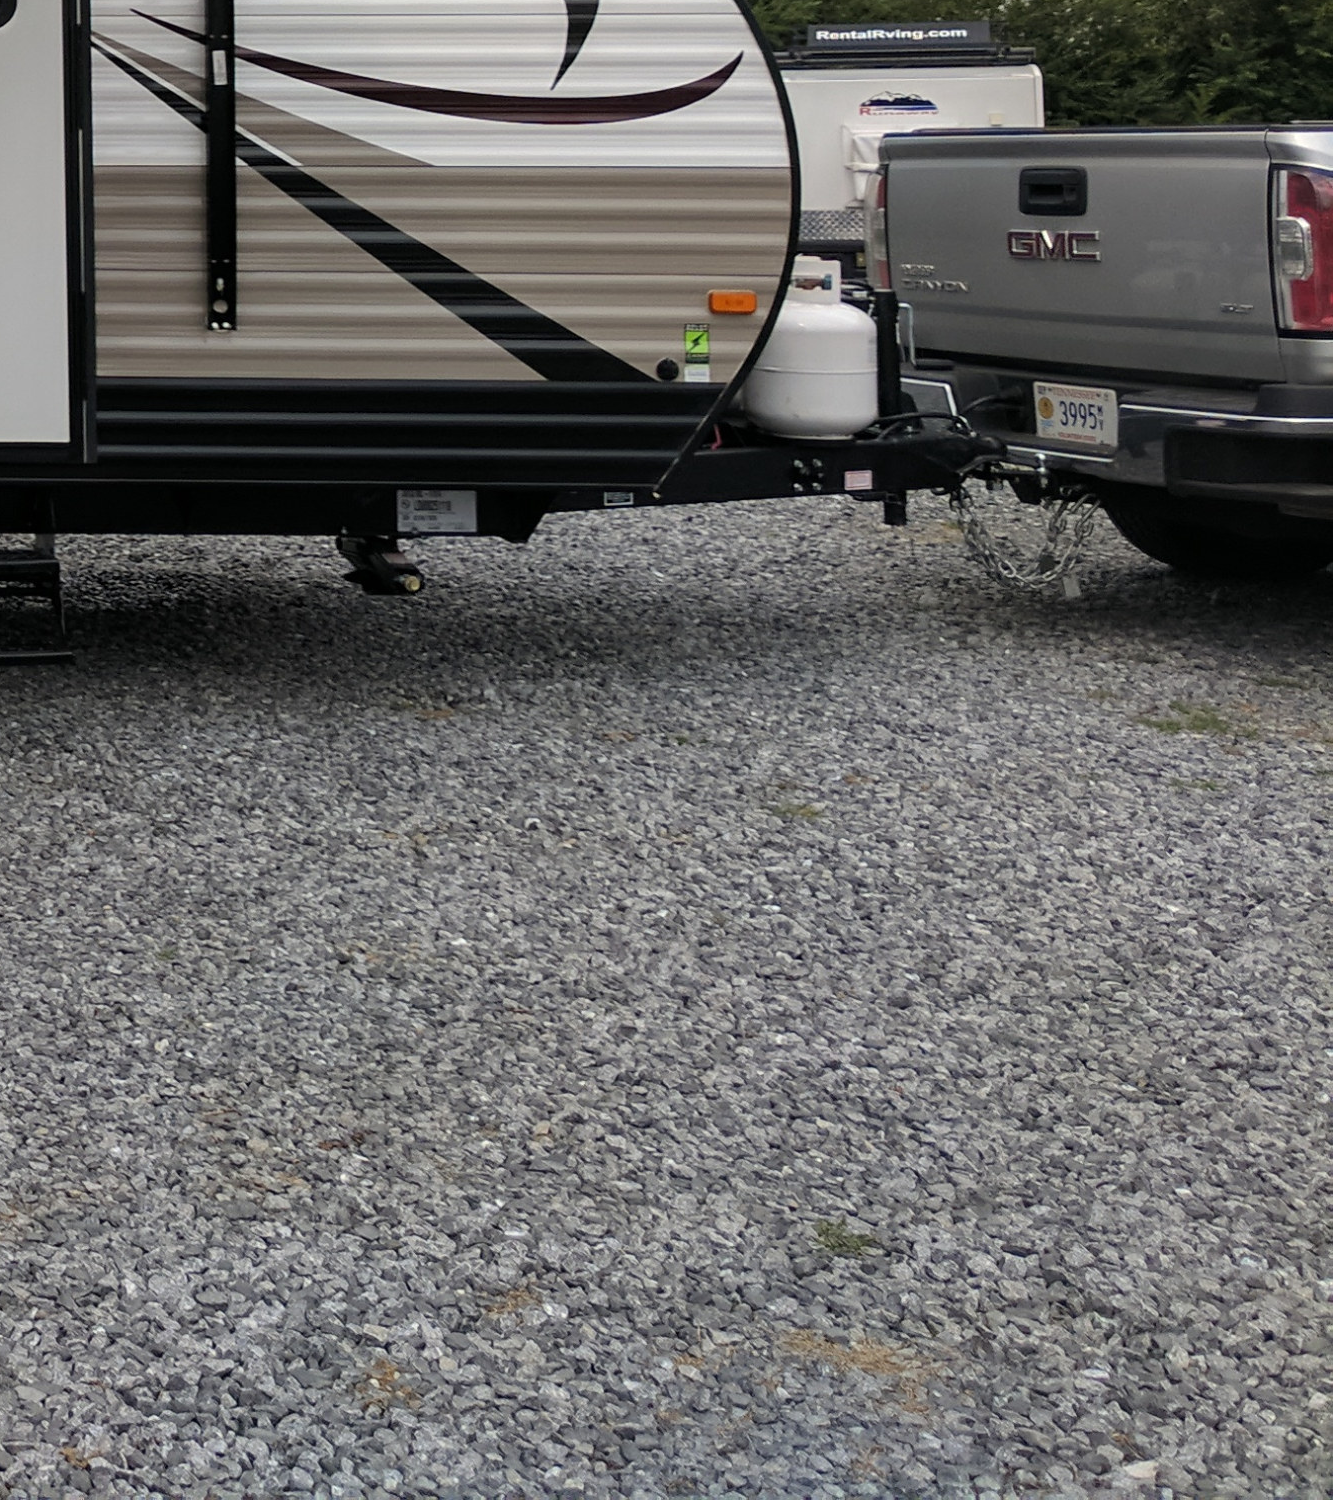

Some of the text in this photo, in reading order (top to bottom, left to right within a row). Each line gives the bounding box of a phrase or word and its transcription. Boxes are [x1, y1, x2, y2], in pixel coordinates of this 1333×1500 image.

[815, 29, 968, 40] RentalRving.com
[1007, 228, 1101, 261] GMC
[1059, 400, 1098, 430] 3995
